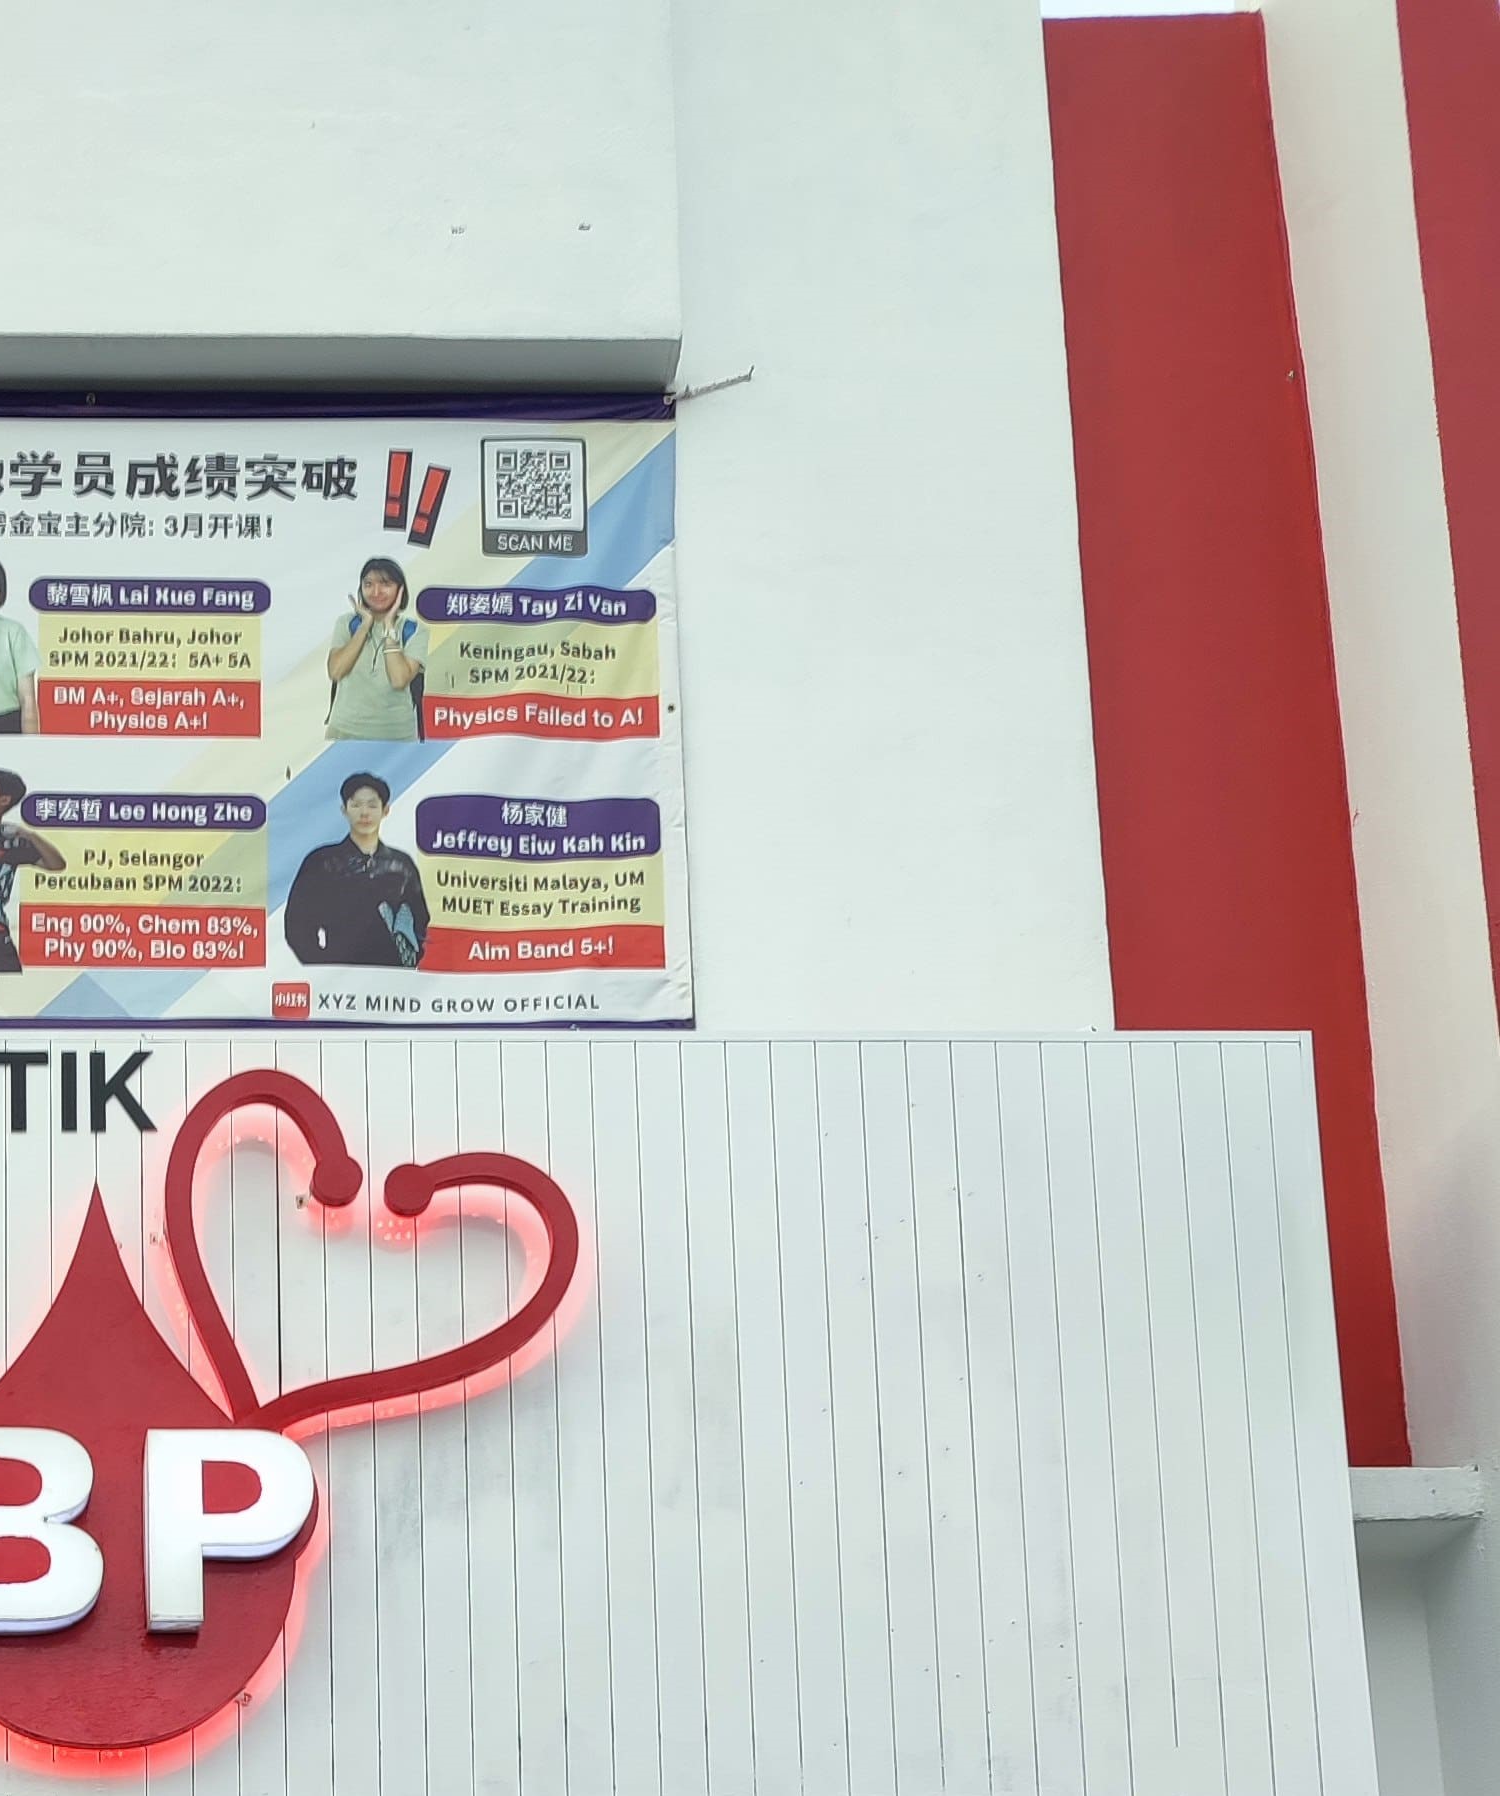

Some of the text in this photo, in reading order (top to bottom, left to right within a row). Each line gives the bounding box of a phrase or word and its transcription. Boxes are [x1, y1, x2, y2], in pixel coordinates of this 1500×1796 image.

[497, 533, 574, 552] SCAN ME
[119, 585, 150, 606] Lai
[155, 587, 196, 606] Xue
[202, 587, 255, 611] Fang
[518, 595, 557, 618] Tay
[563, 591, 583, 612] Zi
[588, 593, 627, 617] Yan
[58, 626, 242, 648] Johor Bahru, Johor
[459, 640, 616, 663] Keningau, Sabah
[89, 711, 168, 733] Physics
[434, 703, 518, 730] Physics
[524, 703, 586, 728] Failed
[591, 707, 614, 728] to
[109, 802, 146, 821] Lee
[152, 802, 208, 826] Hong
[213, 803, 253, 822] Zhe
[432, 829, 646, 857] Jeffrey Eiw Kah Kin
[83, 849, 204, 870] PJ, Selangor
[34, 873, 241, 893] Percubaan SPM 2022:
[436, 868, 645, 894] Universiti Malaya, UM
[442, 895, 641, 918] MUET Essay Training
[468, 940, 510, 961] Aim
[517, 940, 573, 960] Band
[317, 993, 600, 1014] XYZ MIND GROW OFFICIAL
